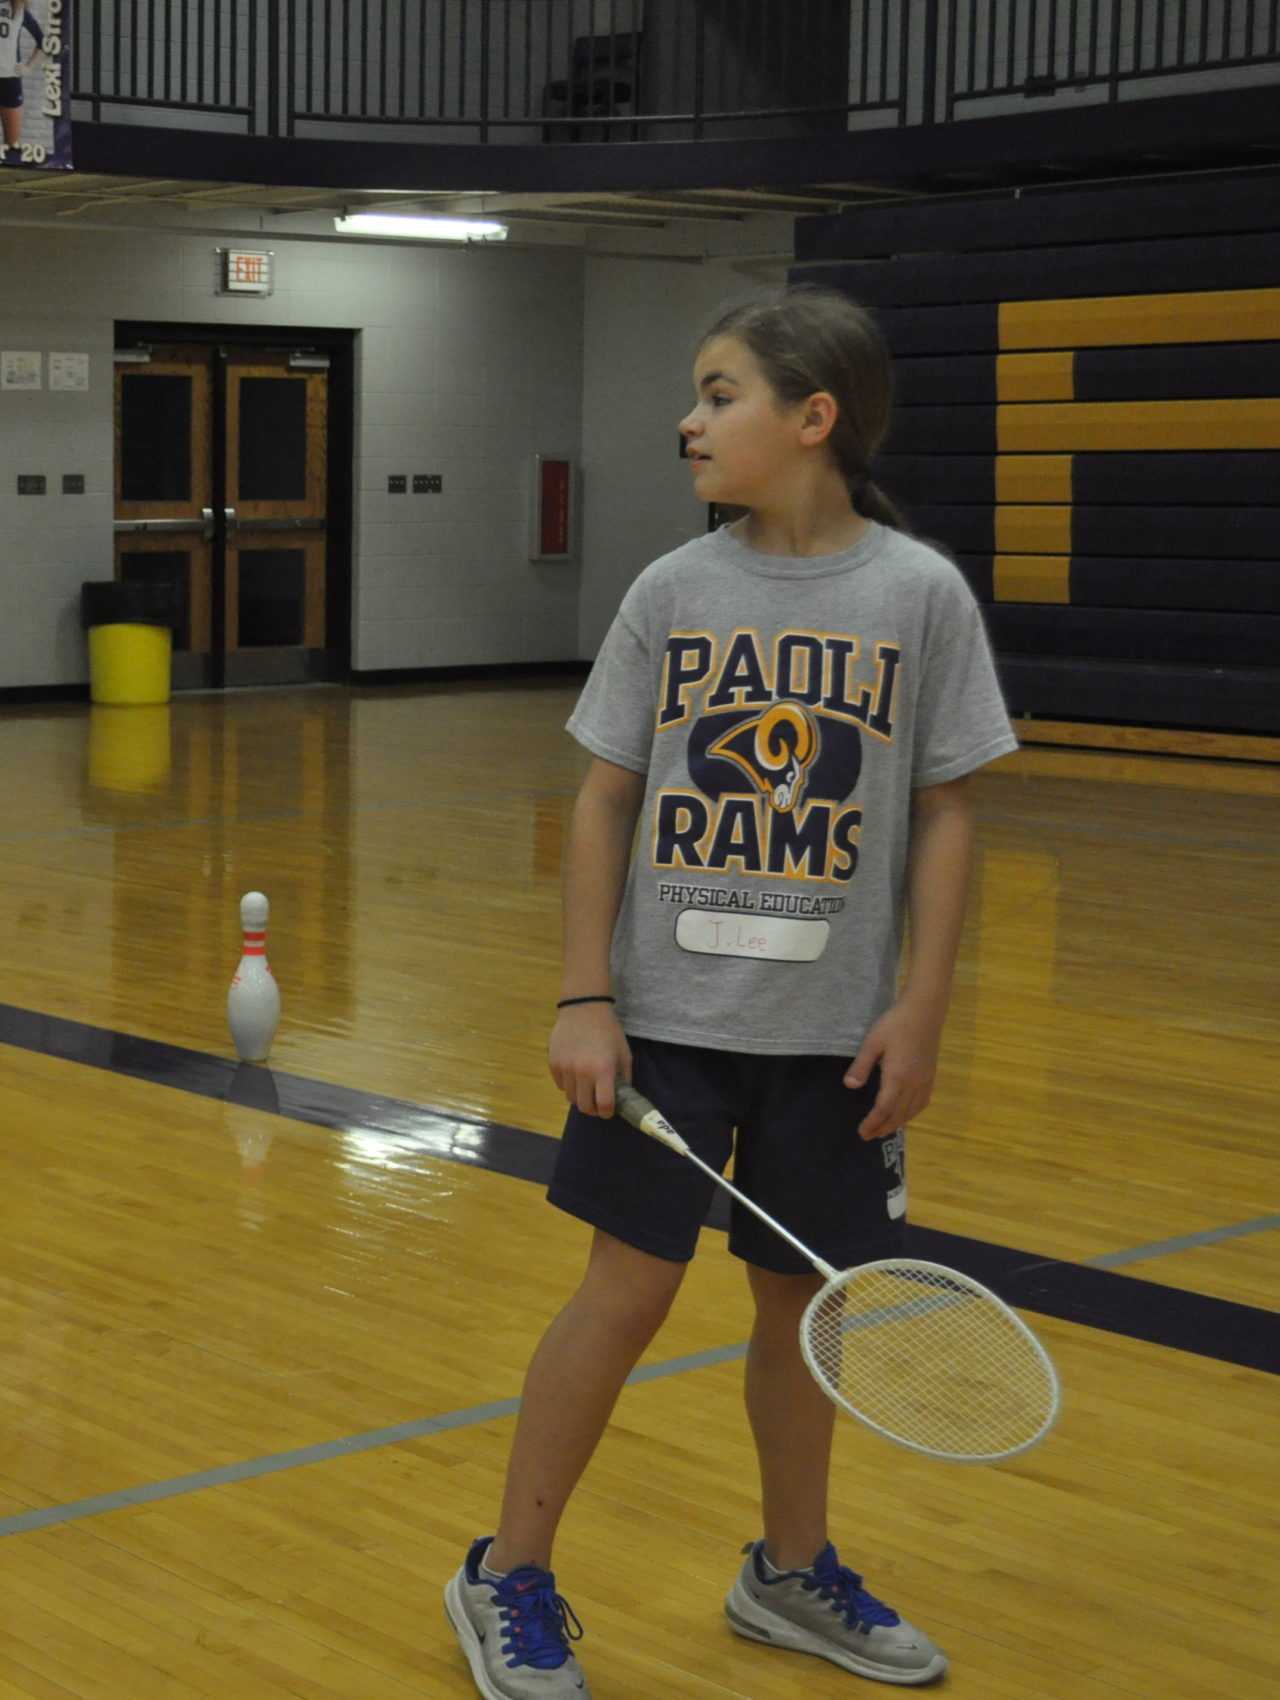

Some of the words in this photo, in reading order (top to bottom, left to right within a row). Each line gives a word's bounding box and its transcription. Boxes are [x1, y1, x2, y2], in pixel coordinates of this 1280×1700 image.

[41, 62, 62, 116] Lexi
[235, 255, 264, 284] EXIT
[657, 627, 901, 745] PAOLI
[653, 788, 864, 884] RAMS
[659, 884, 754, 910] PHYSICAL
